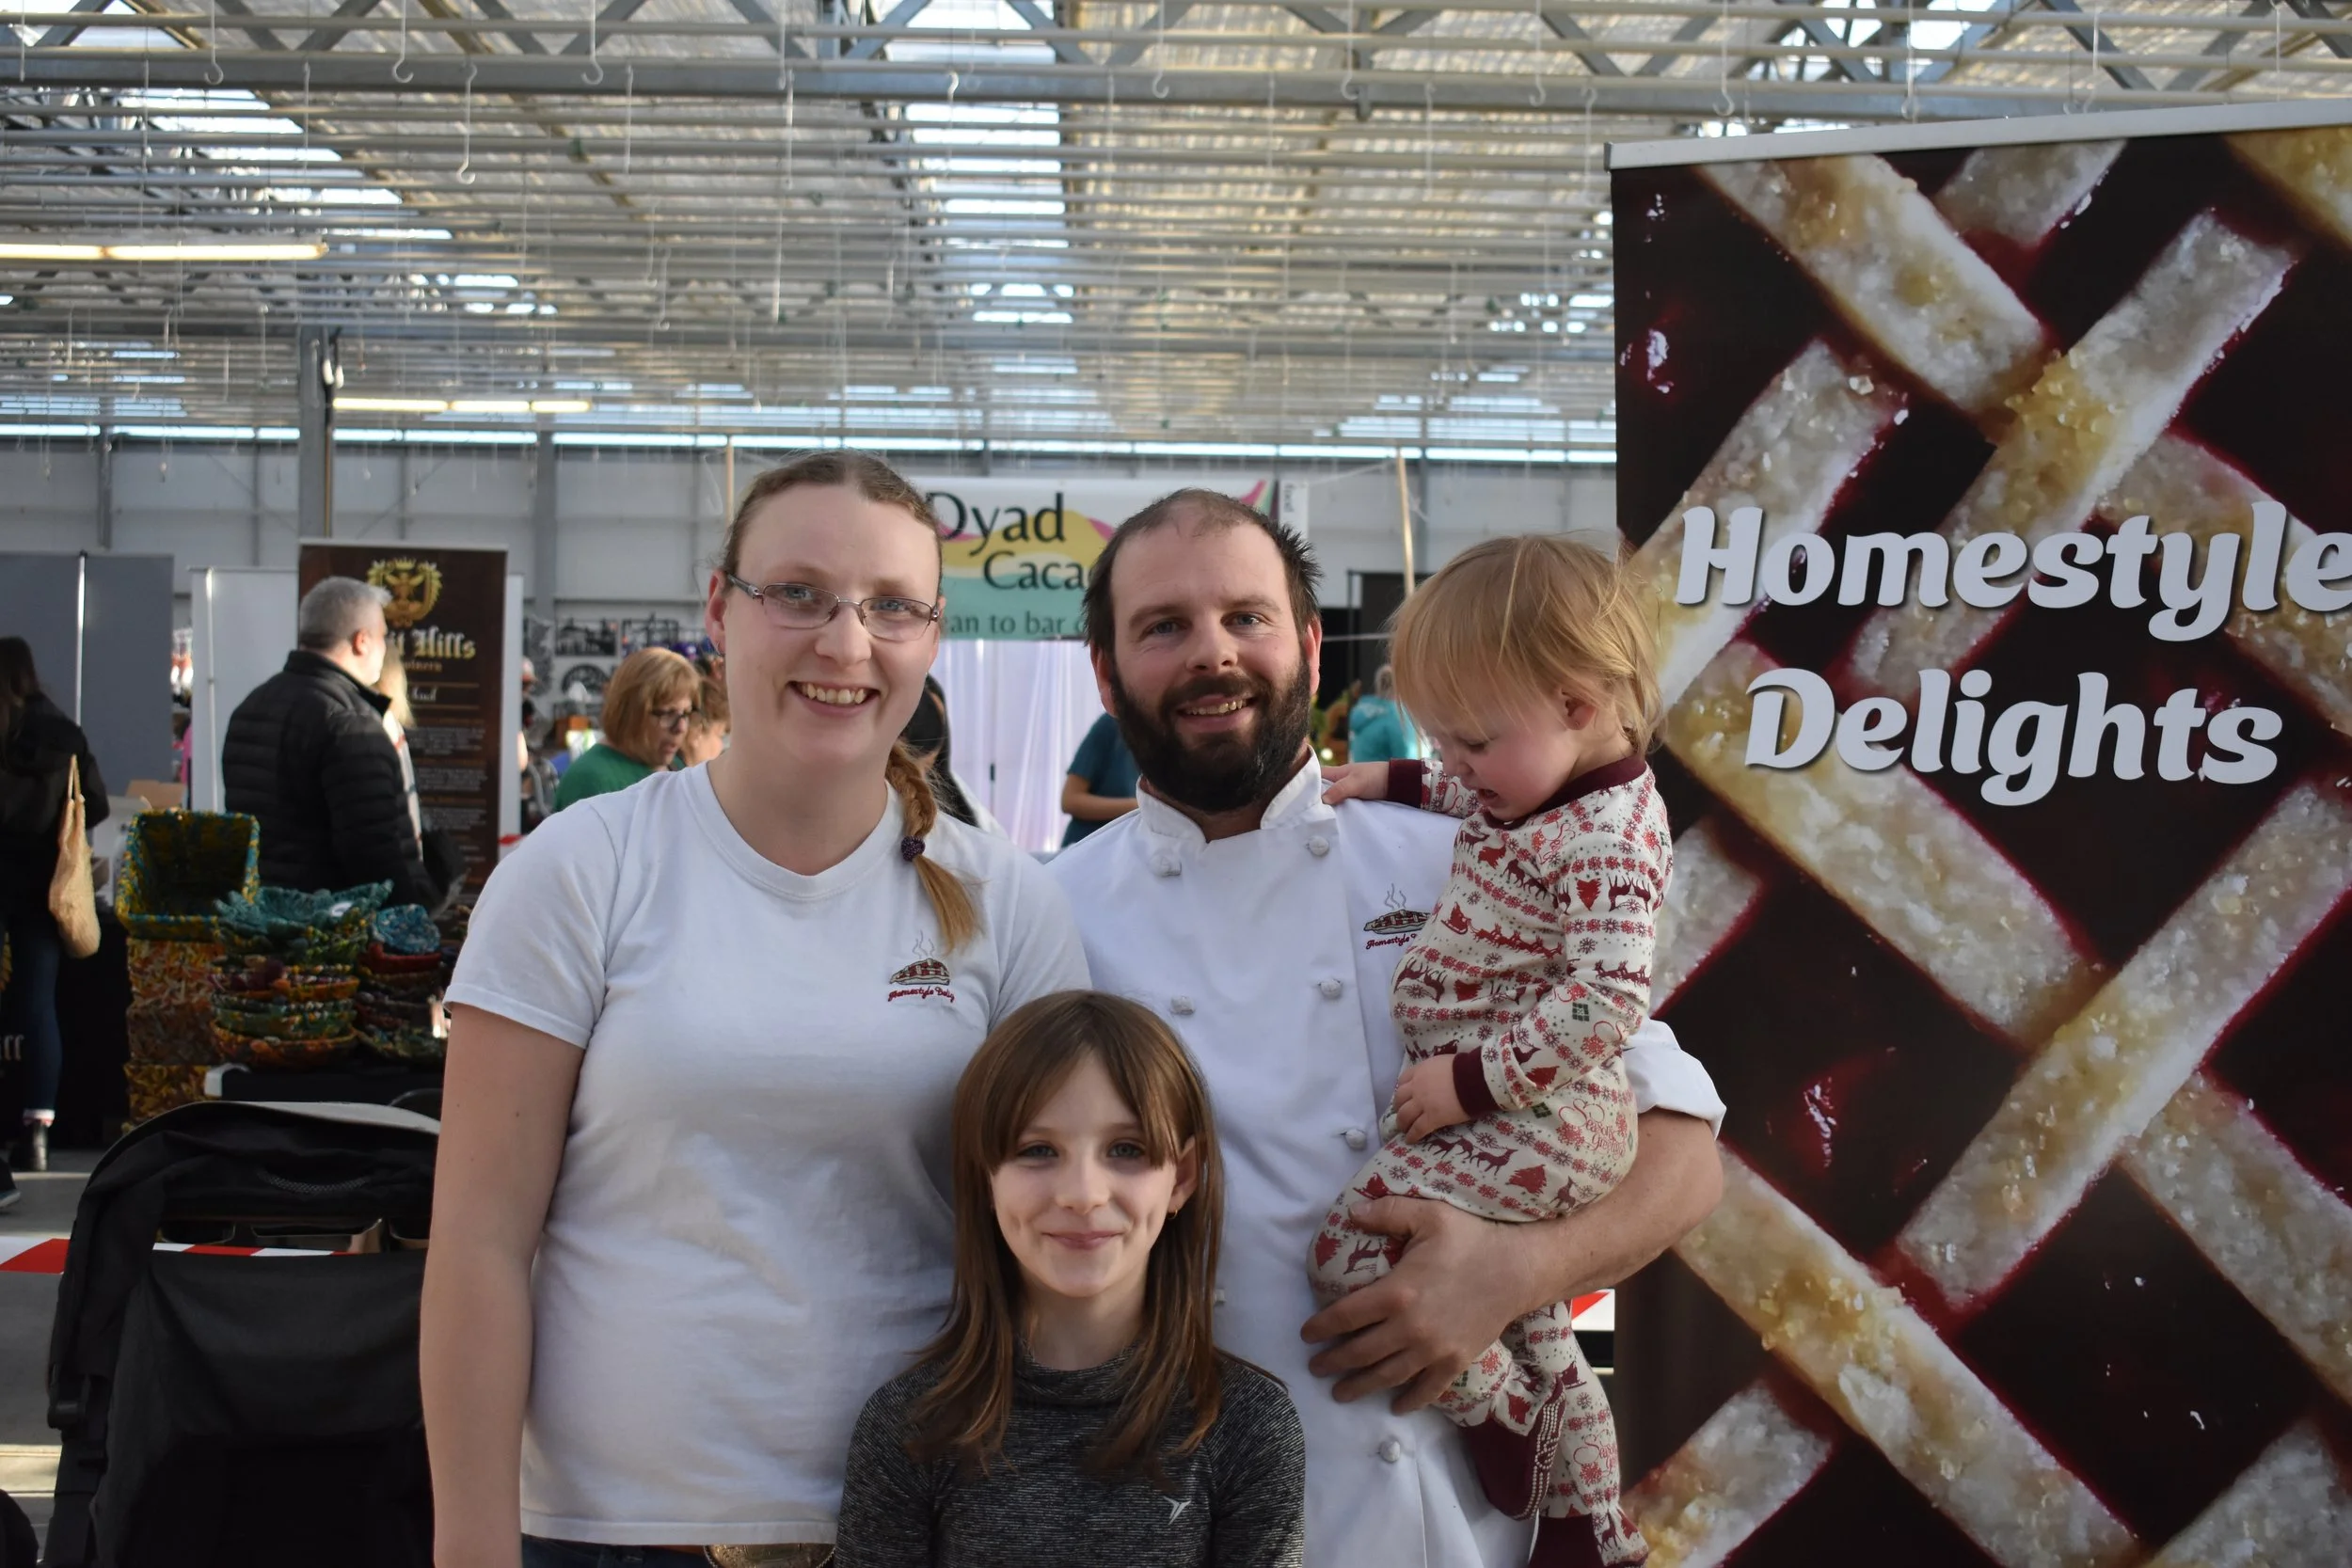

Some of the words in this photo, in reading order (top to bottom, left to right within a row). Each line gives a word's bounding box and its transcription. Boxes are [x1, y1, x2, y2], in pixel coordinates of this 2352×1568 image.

[926, 491, 1066, 557] Dyad
[983, 549, 1091, 591] Caca
[1677, 500, 2352, 642] Homestyle
[990, 612, 1016, 635] to
[1025, 610, 1066, 635] bar
[1744, 668, 2283, 806] Delights
[1366, 935, 1409, 950] Homestyle
[887, 986, 934, 1002] Homestyle
